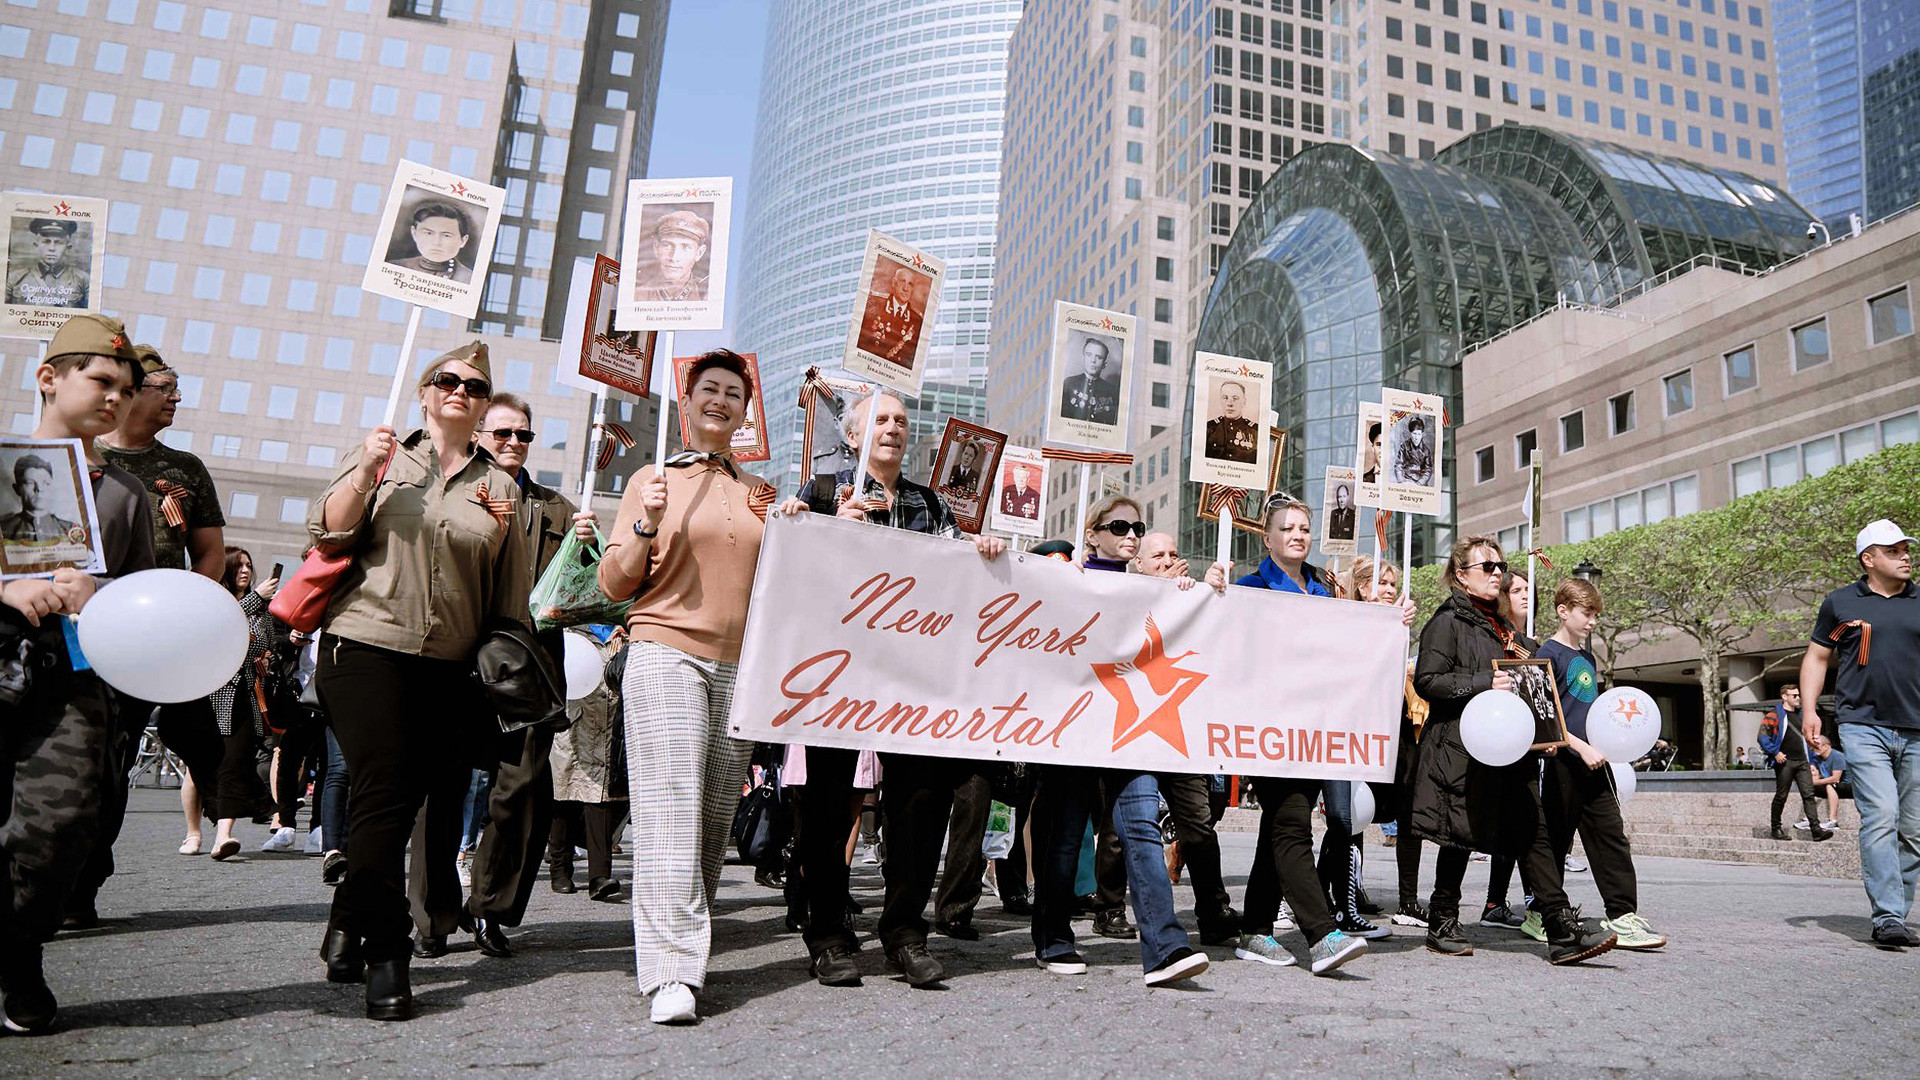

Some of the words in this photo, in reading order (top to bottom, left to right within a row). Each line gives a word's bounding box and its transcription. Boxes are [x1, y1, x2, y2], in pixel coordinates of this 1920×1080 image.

[381, 267, 405, 279] Петр
[411, 274, 469, 295] Гаврилович
[393, 277, 454, 300] Троицкий
[20, 319, 64, 329] Осипчу
[34, 310, 75, 319] Карпови
[841, 572, 954, 637] New
[974, 592, 1101, 668] York
[771, 649, 1094, 748] Immortal
[1206, 722, 1391, 768] REGIMENT
